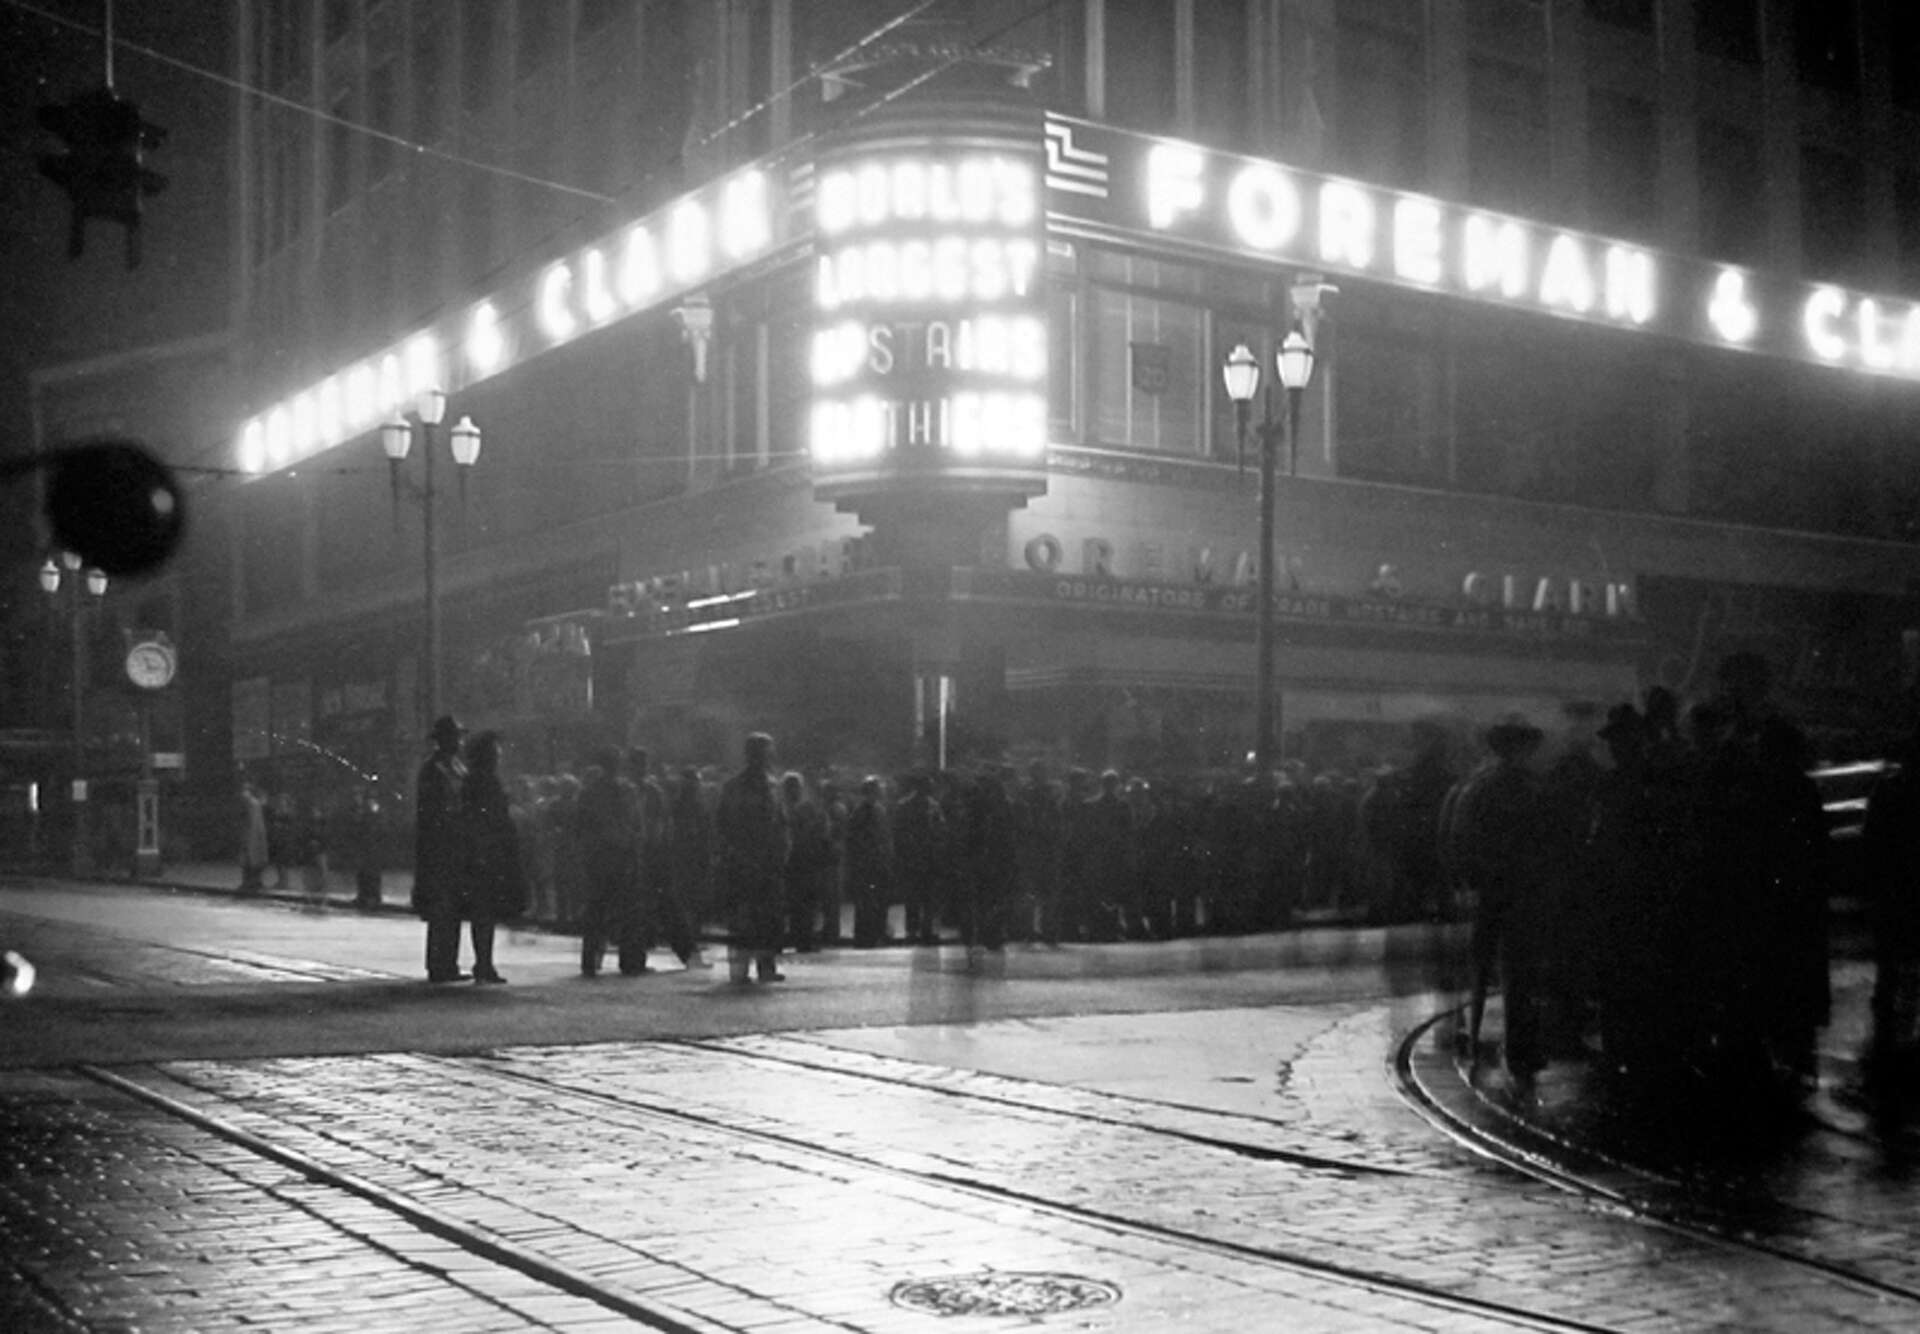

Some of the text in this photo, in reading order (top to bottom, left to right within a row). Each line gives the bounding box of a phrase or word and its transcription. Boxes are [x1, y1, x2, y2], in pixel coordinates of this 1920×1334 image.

[1147, 143, 1657, 326] FOREMAN
[1708, 268, 1758, 343] &
[1222, 594, 1250, 611] OF
